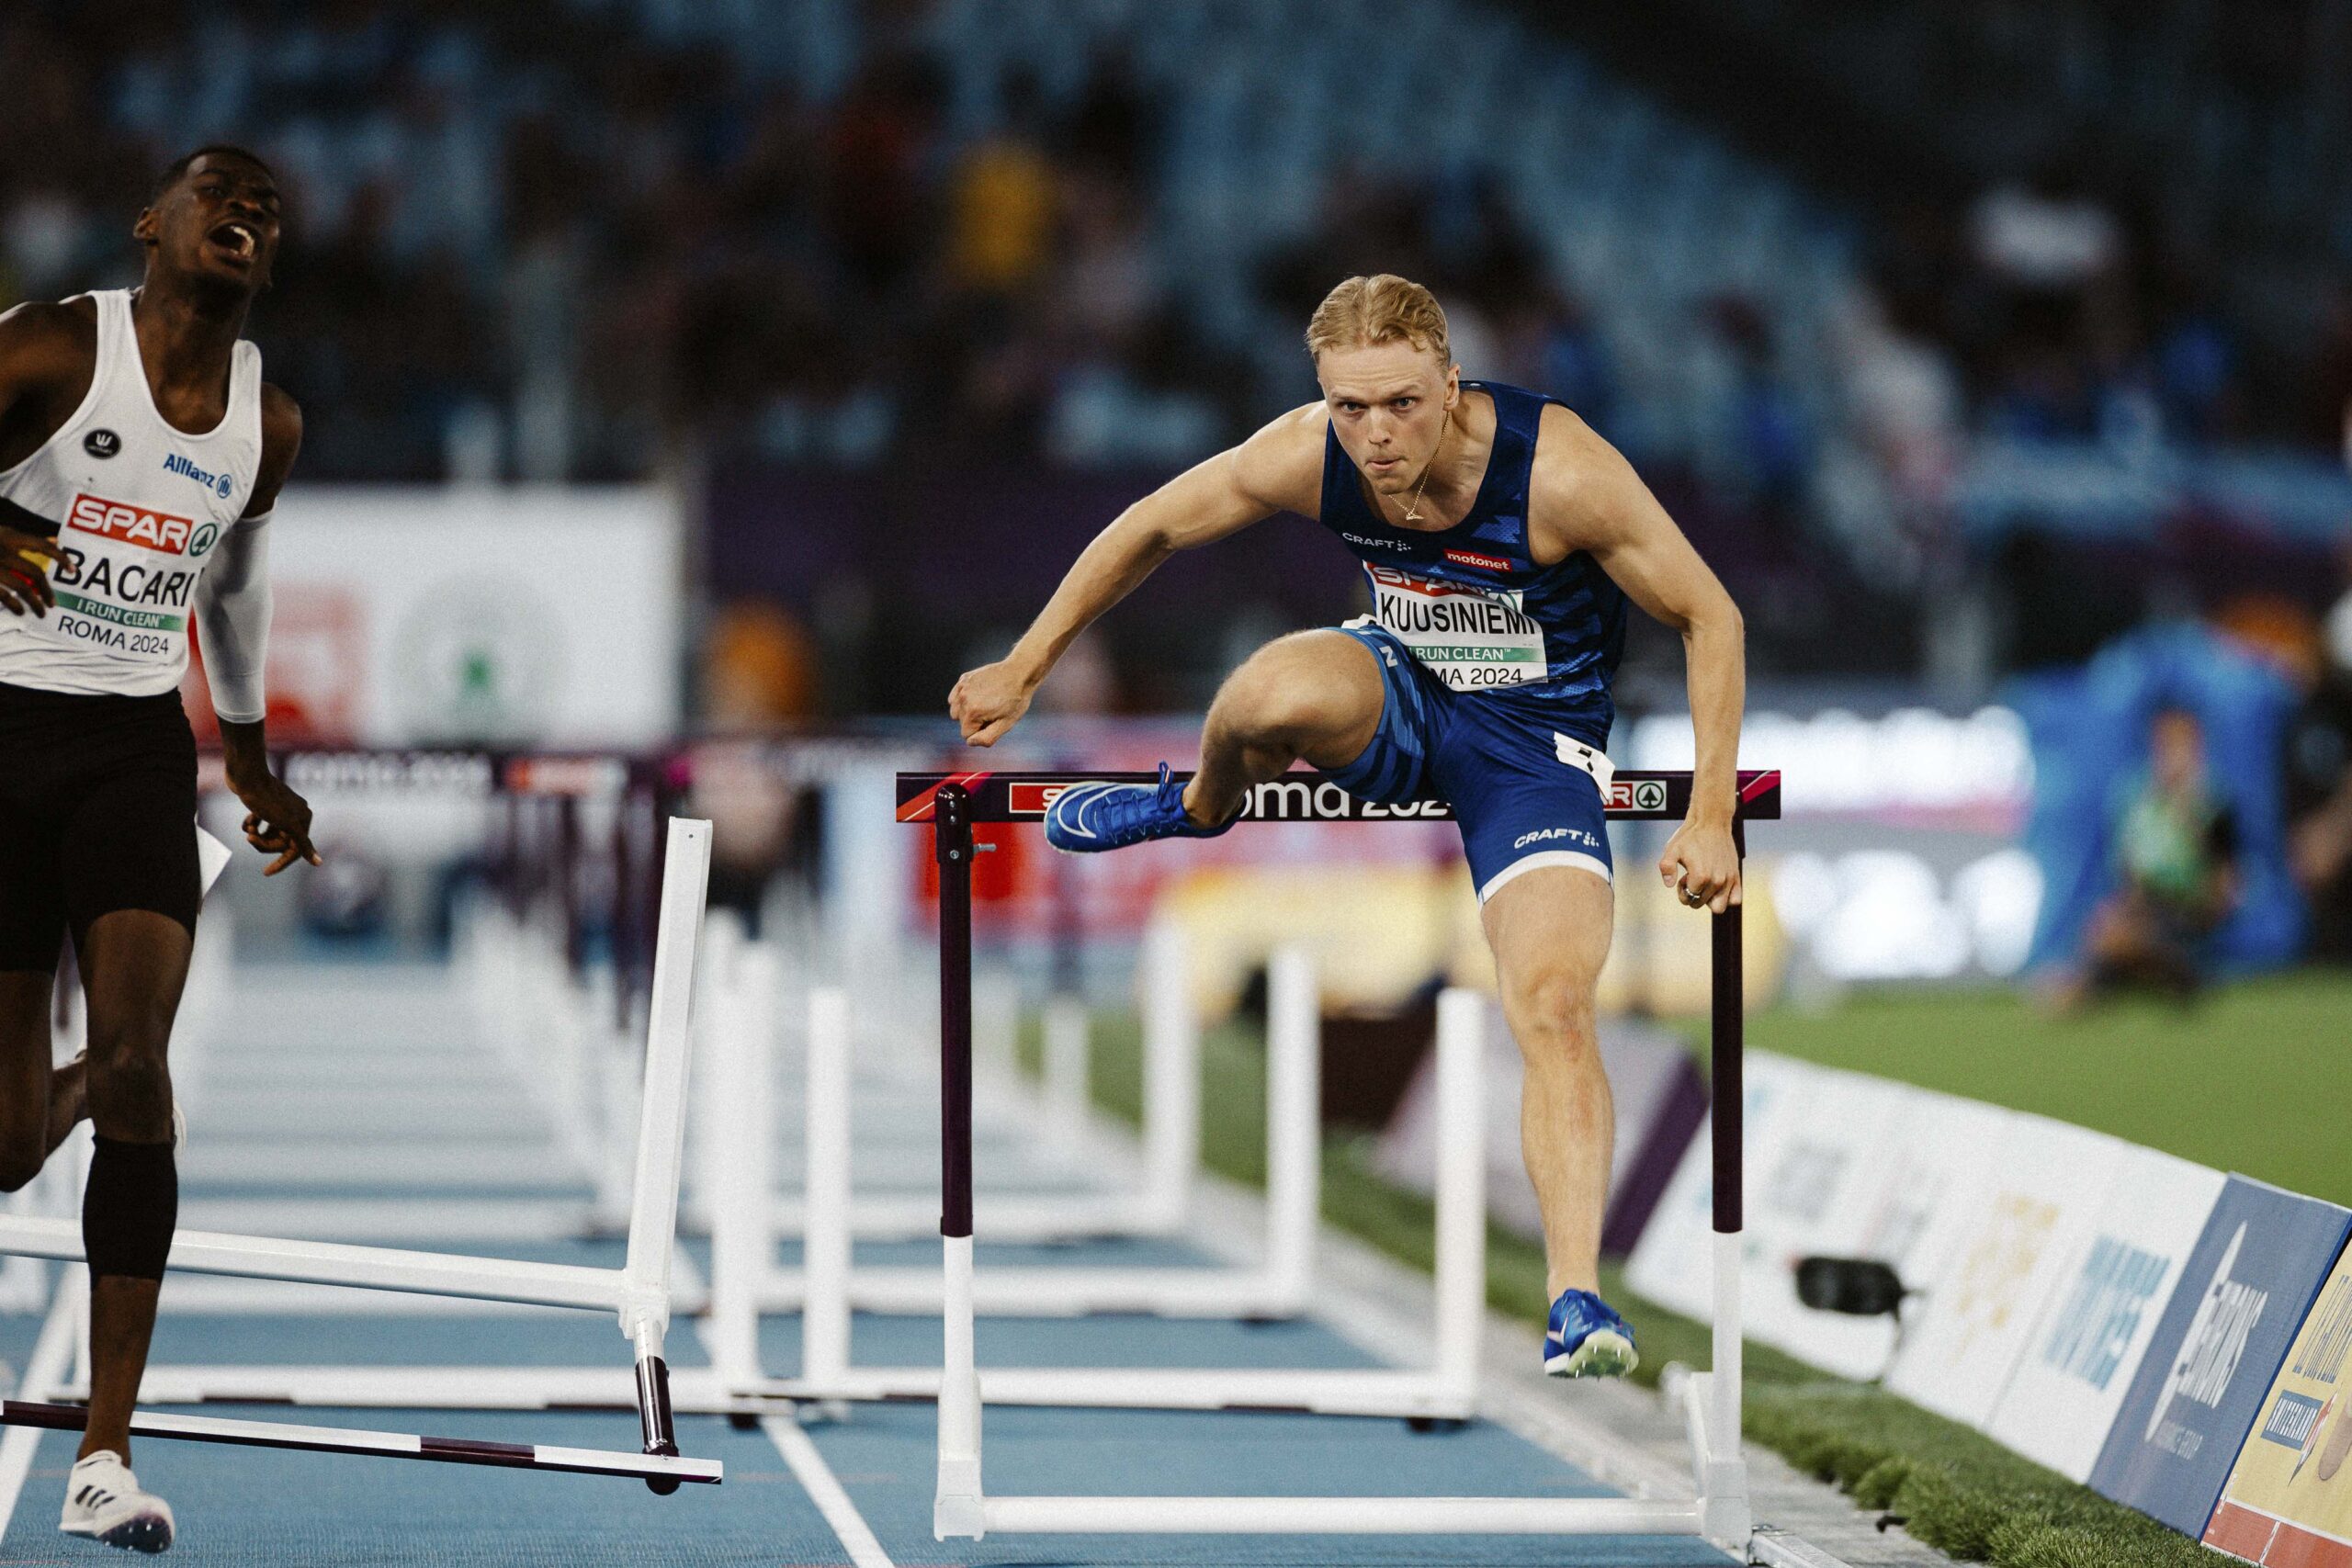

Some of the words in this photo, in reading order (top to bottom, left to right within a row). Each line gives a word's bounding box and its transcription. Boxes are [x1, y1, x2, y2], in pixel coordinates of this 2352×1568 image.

[163, 453, 216, 489] Allianz
[72, 499, 189, 551] SPAR
[1341, 532, 1396, 549] CRAFT
[1446, 551, 1510, 570] motonet
[52, 546, 196, 607] BACARI
[76, 598, 85, 611] I
[85, 602, 122, 623] RUN
[1379, 592, 1535, 635] KUUSINIEMI
[58, 615, 126, 650] ROMA
[130, 634, 169, 655] 2024
[1416, 647, 1450, 660] RUN
[1470, 668, 1523, 685] 2024
[1513, 828, 1583, 850] CRAFT
